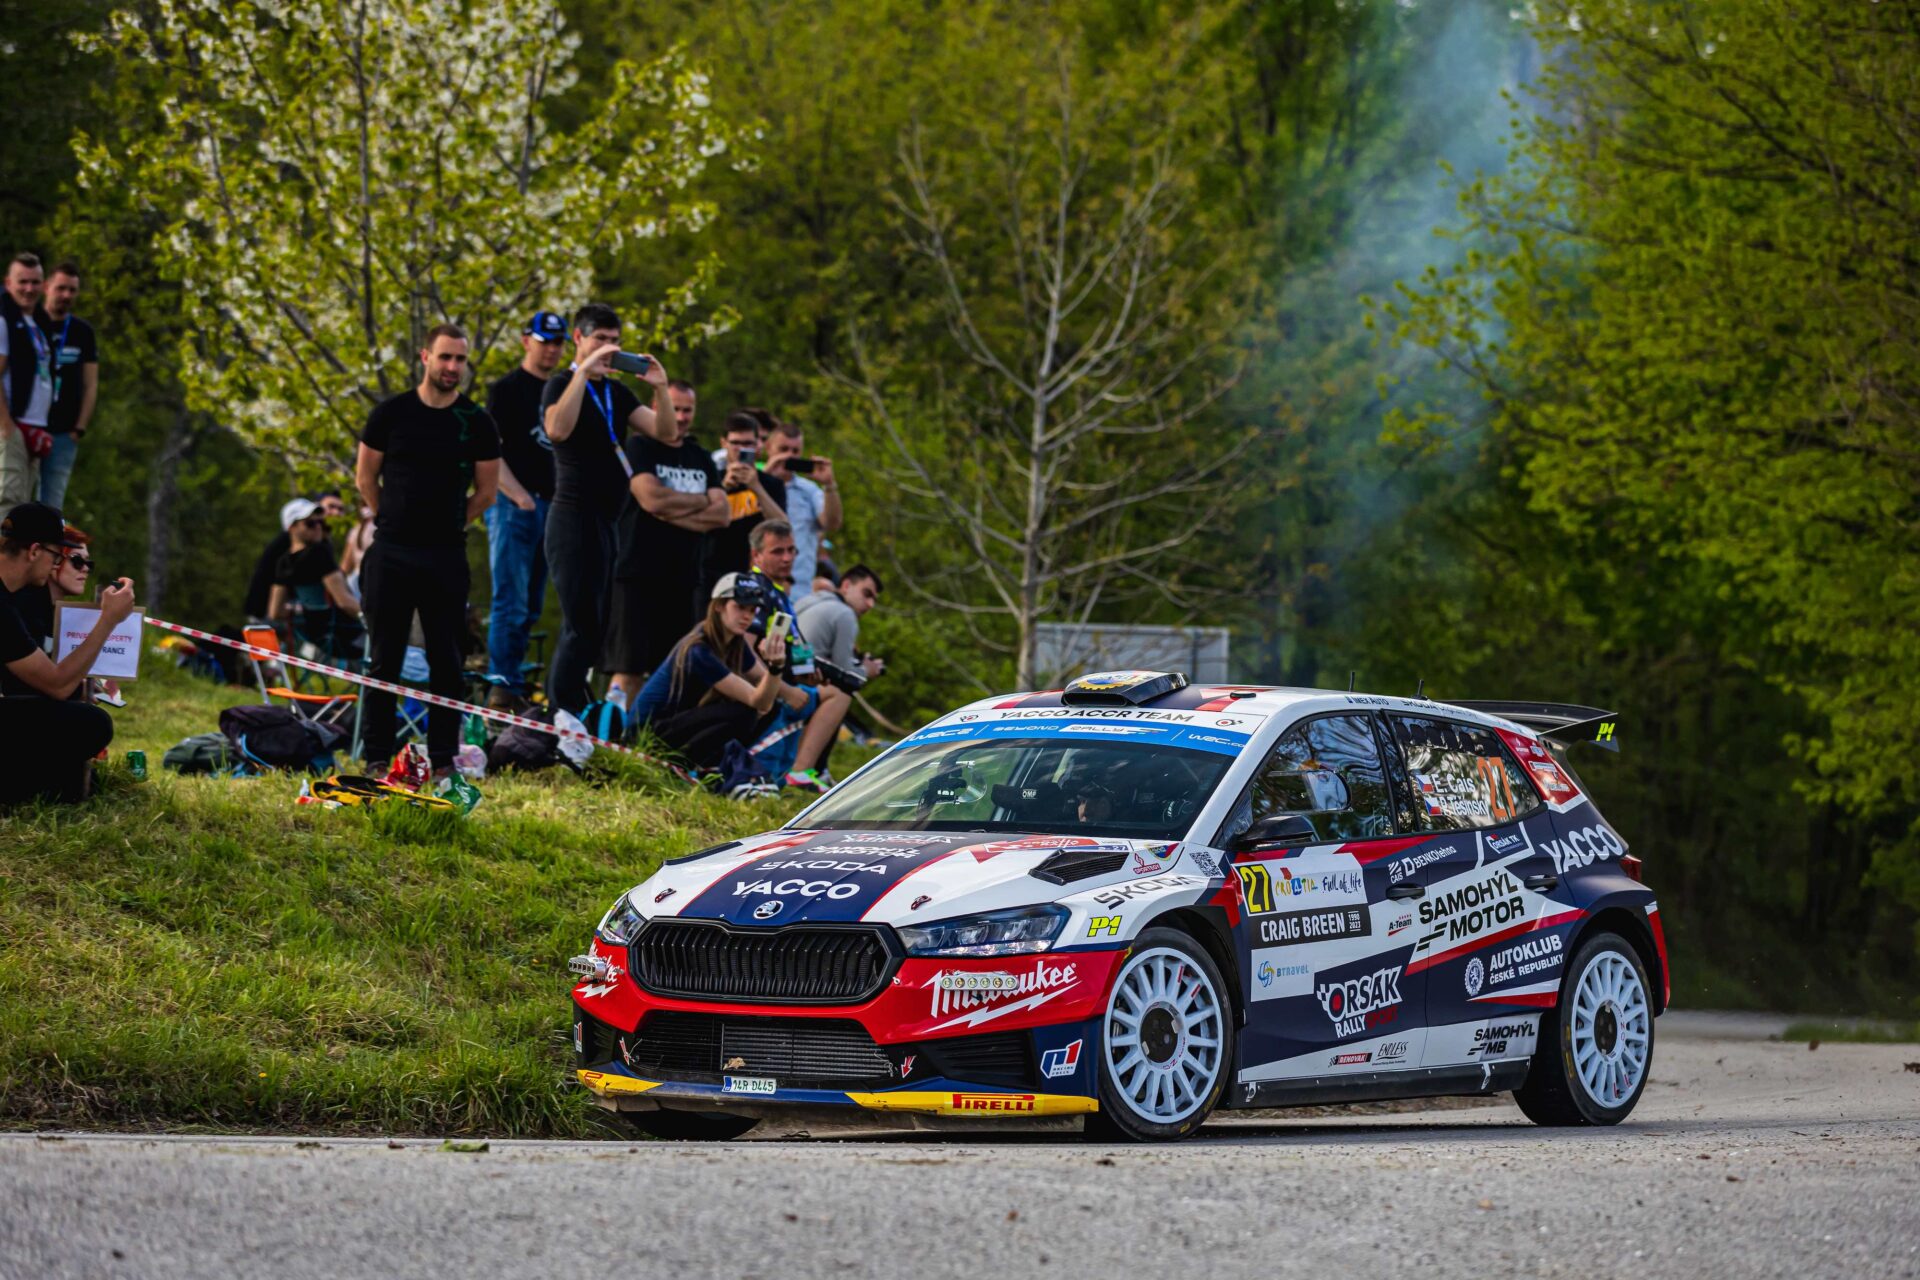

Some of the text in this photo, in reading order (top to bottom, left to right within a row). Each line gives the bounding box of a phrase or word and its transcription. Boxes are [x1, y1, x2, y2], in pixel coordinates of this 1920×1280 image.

[655, 463, 707, 481] umbro
[102, 646, 126, 655] RANCE
[1000, 709, 1195, 722] YACCO ACCR TEAM
[1187, 732, 1246, 749] WRC.co
[1595, 723, 1616, 742] P1
[1022, 789, 1037, 799] OMP
[1431, 773, 1476, 794] E. Cais
[1476, 756, 1517, 817] 27
[1539, 823, 1625, 875] YACCO
[732, 878, 861, 900] YACCO
[1239, 865, 1274, 913] 27
[1418, 870, 1519, 925] SAMOHÝL
[1087, 915, 1123, 938] P1
[1260, 917, 1300, 942] CRAIG
[1301, 912, 1345, 937] BREEN
[1388, 918, 1413, 931] A-Team
[1449, 895, 1525, 942] MOTOR
[1489, 934, 1563, 972] AUTOKLUB
[1489, 953, 1564, 985] ČESKÉ REPUBLIKY
[1473, 1020, 1536, 1041] SAMOHÝL
[1376, 1041, 1409, 1057] ENDLESS
[1484, 1040, 1508, 1055] MB
[732, 1079, 749, 1091] 14R
[751, 1080, 775, 1092] D445
[952, 1093, 1036, 1111] PIRELLI
